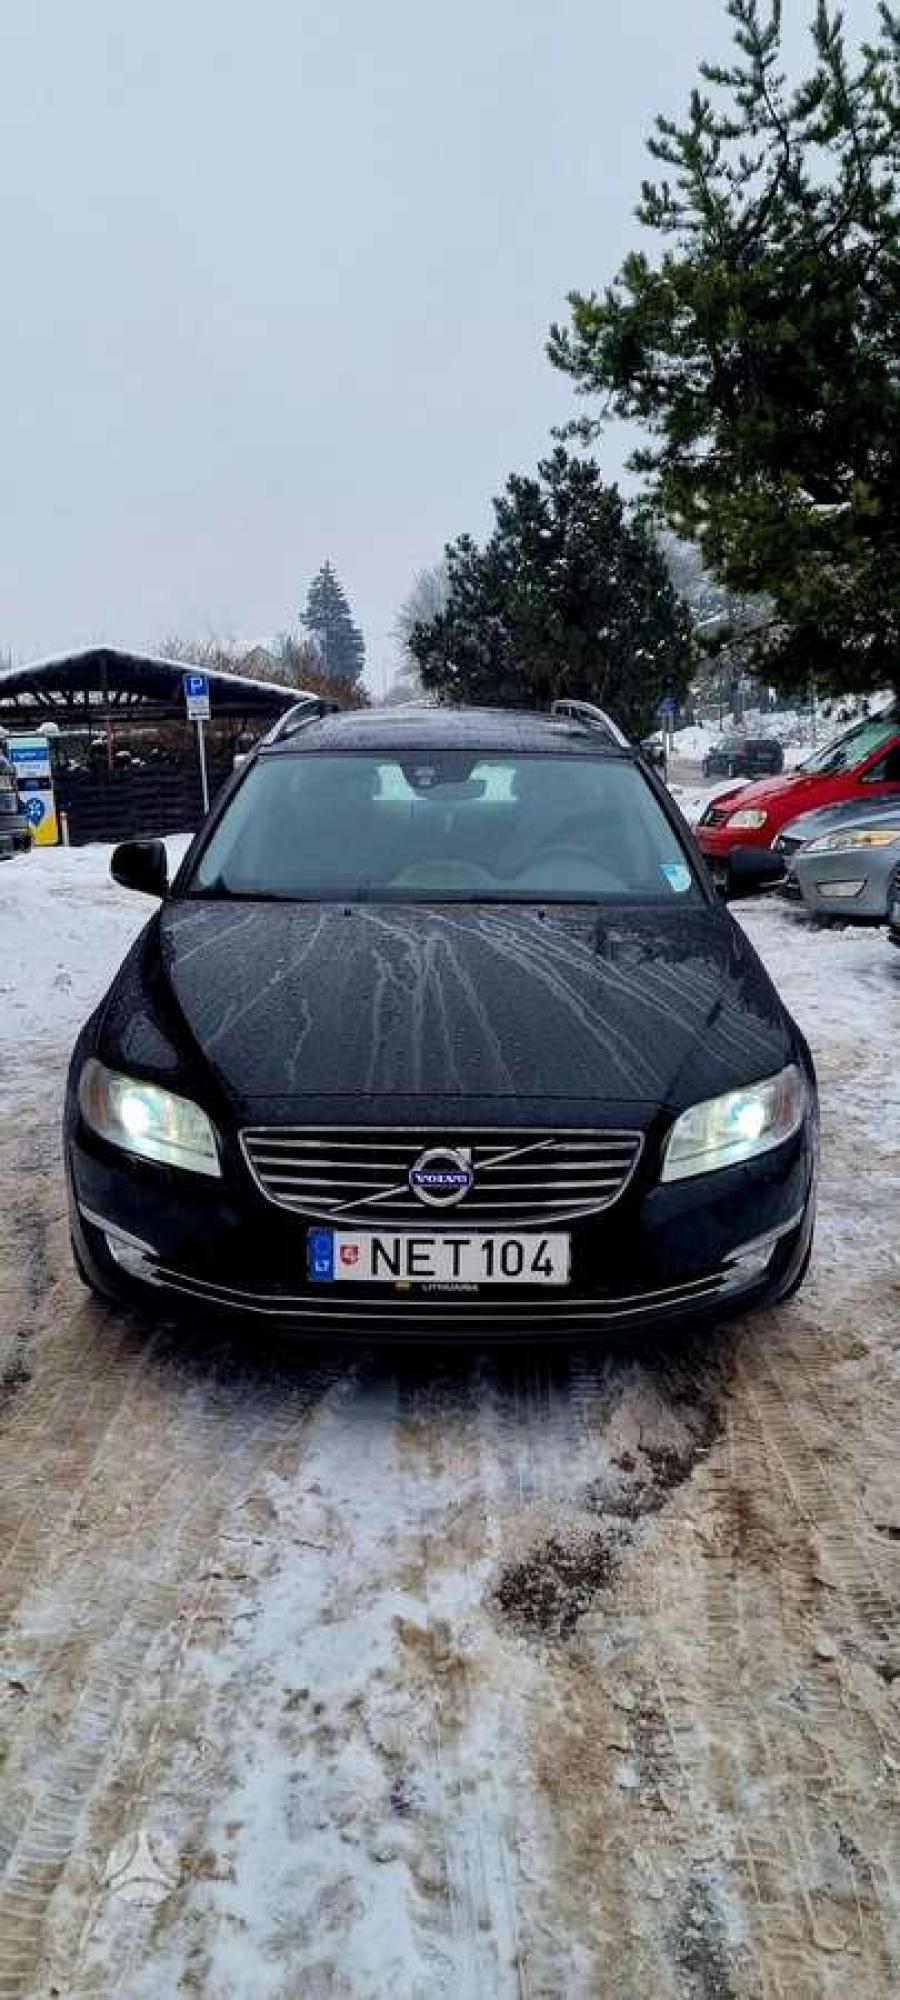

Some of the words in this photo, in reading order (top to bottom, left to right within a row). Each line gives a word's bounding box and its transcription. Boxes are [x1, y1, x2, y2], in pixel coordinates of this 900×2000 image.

[190, 677, 203, 694] P
[415, 1173, 468, 1183] VOLVO
[370, 1238, 471, 1277] NET
[481, 1239, 554, 1277] 104
